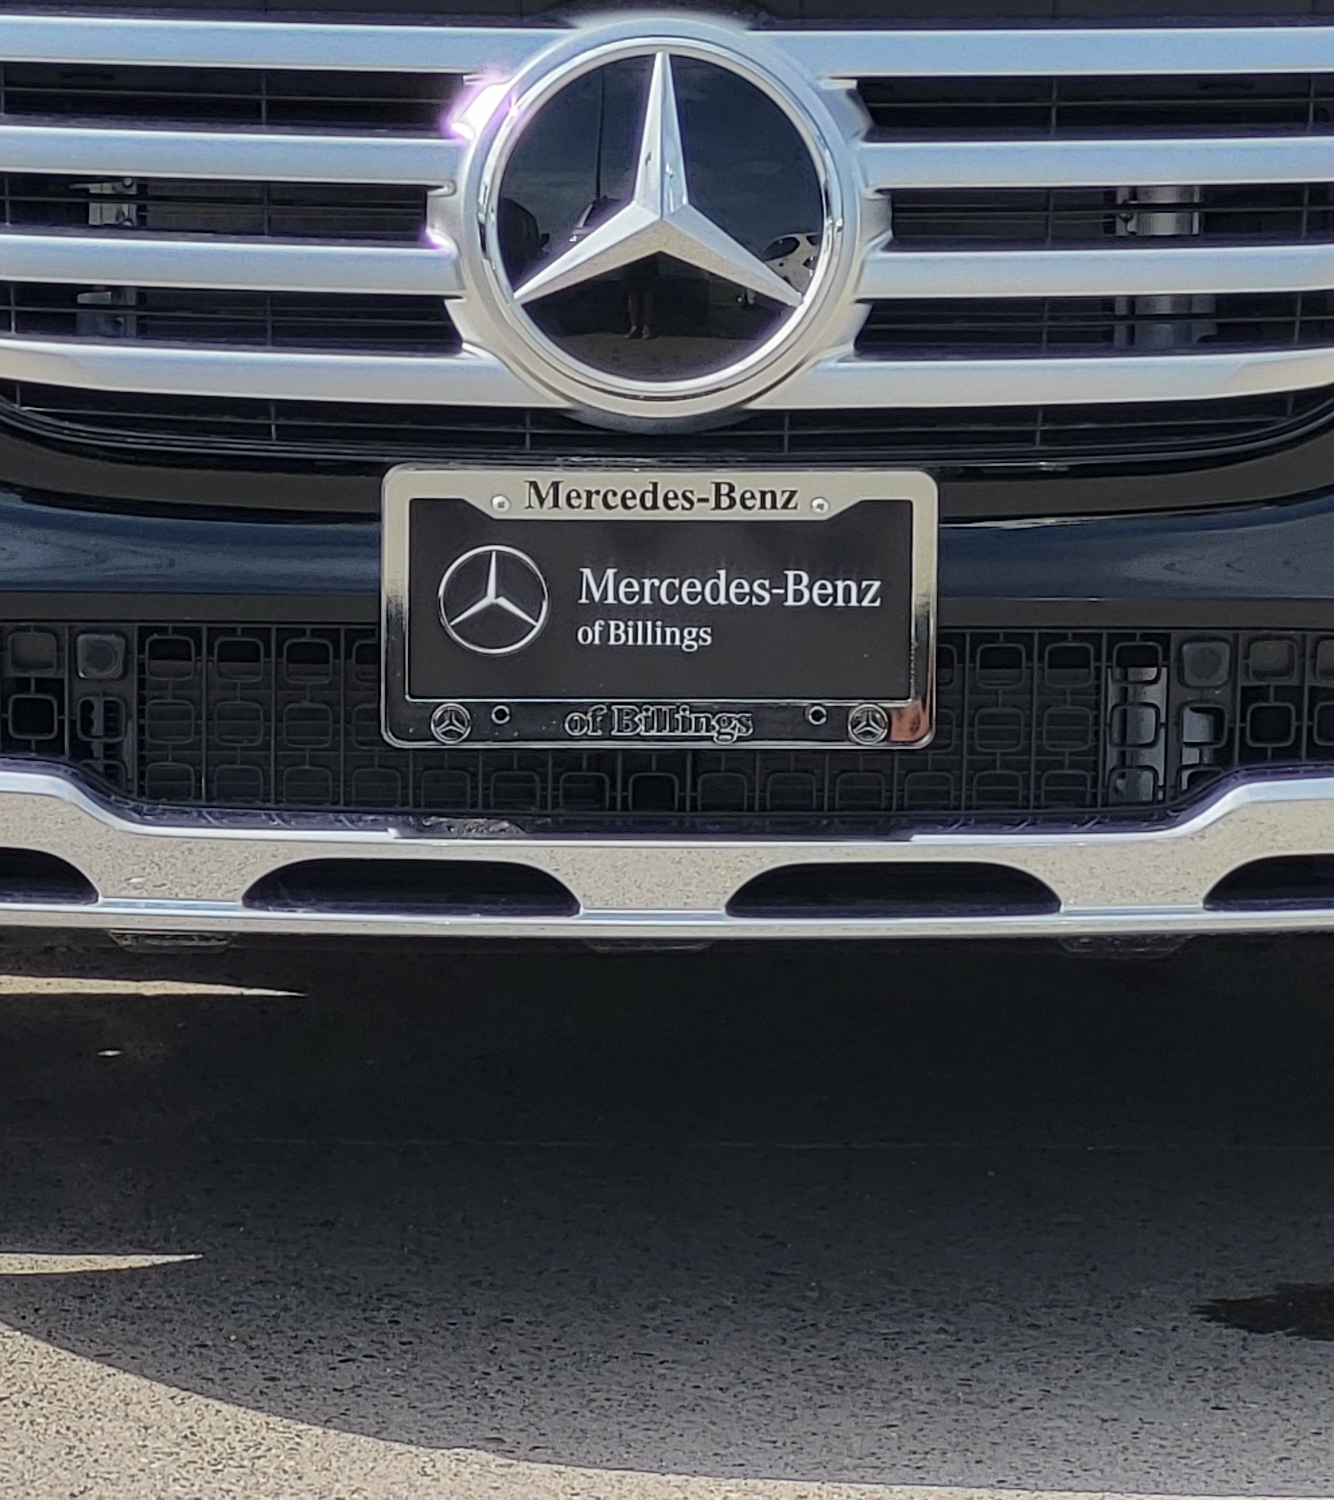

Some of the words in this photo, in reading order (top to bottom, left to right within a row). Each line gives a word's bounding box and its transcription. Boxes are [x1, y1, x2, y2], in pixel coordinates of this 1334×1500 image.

[525, 480, 799, 511] Mercedes-Benz
[577, 567, 882, 607] Mercedes-Benz
[577, 619, 605, 646] of
[607, 620, 712, 652] Billings
[564, 704, 608, 736] of
[611, 704, 754, 745] Billings
